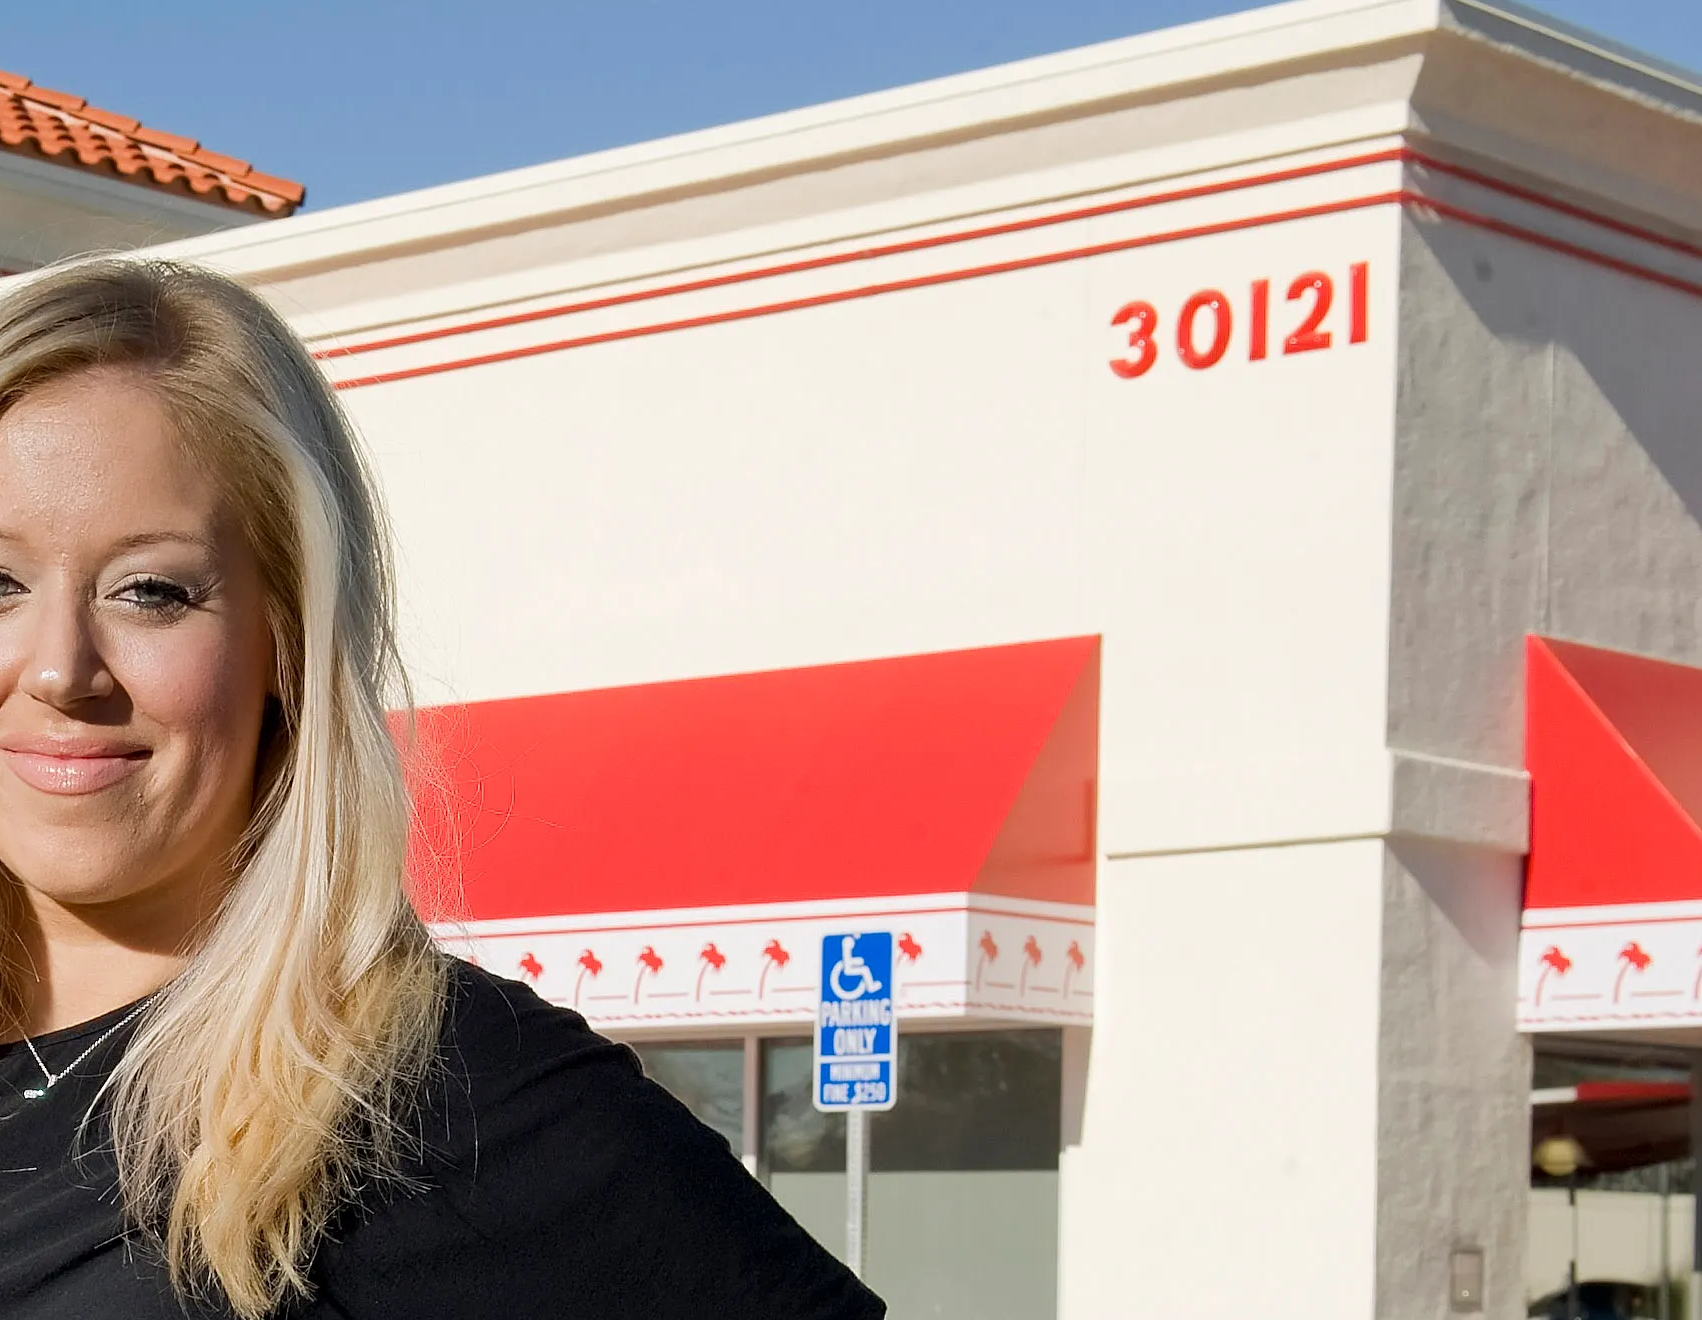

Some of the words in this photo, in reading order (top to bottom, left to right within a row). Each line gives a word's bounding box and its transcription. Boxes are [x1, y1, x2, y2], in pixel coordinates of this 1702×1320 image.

[1108, 260, 1370, 380] 30121
[819, 998, 892, 1027] PARKING
[833, 1027, 877, 1055] ONLY
